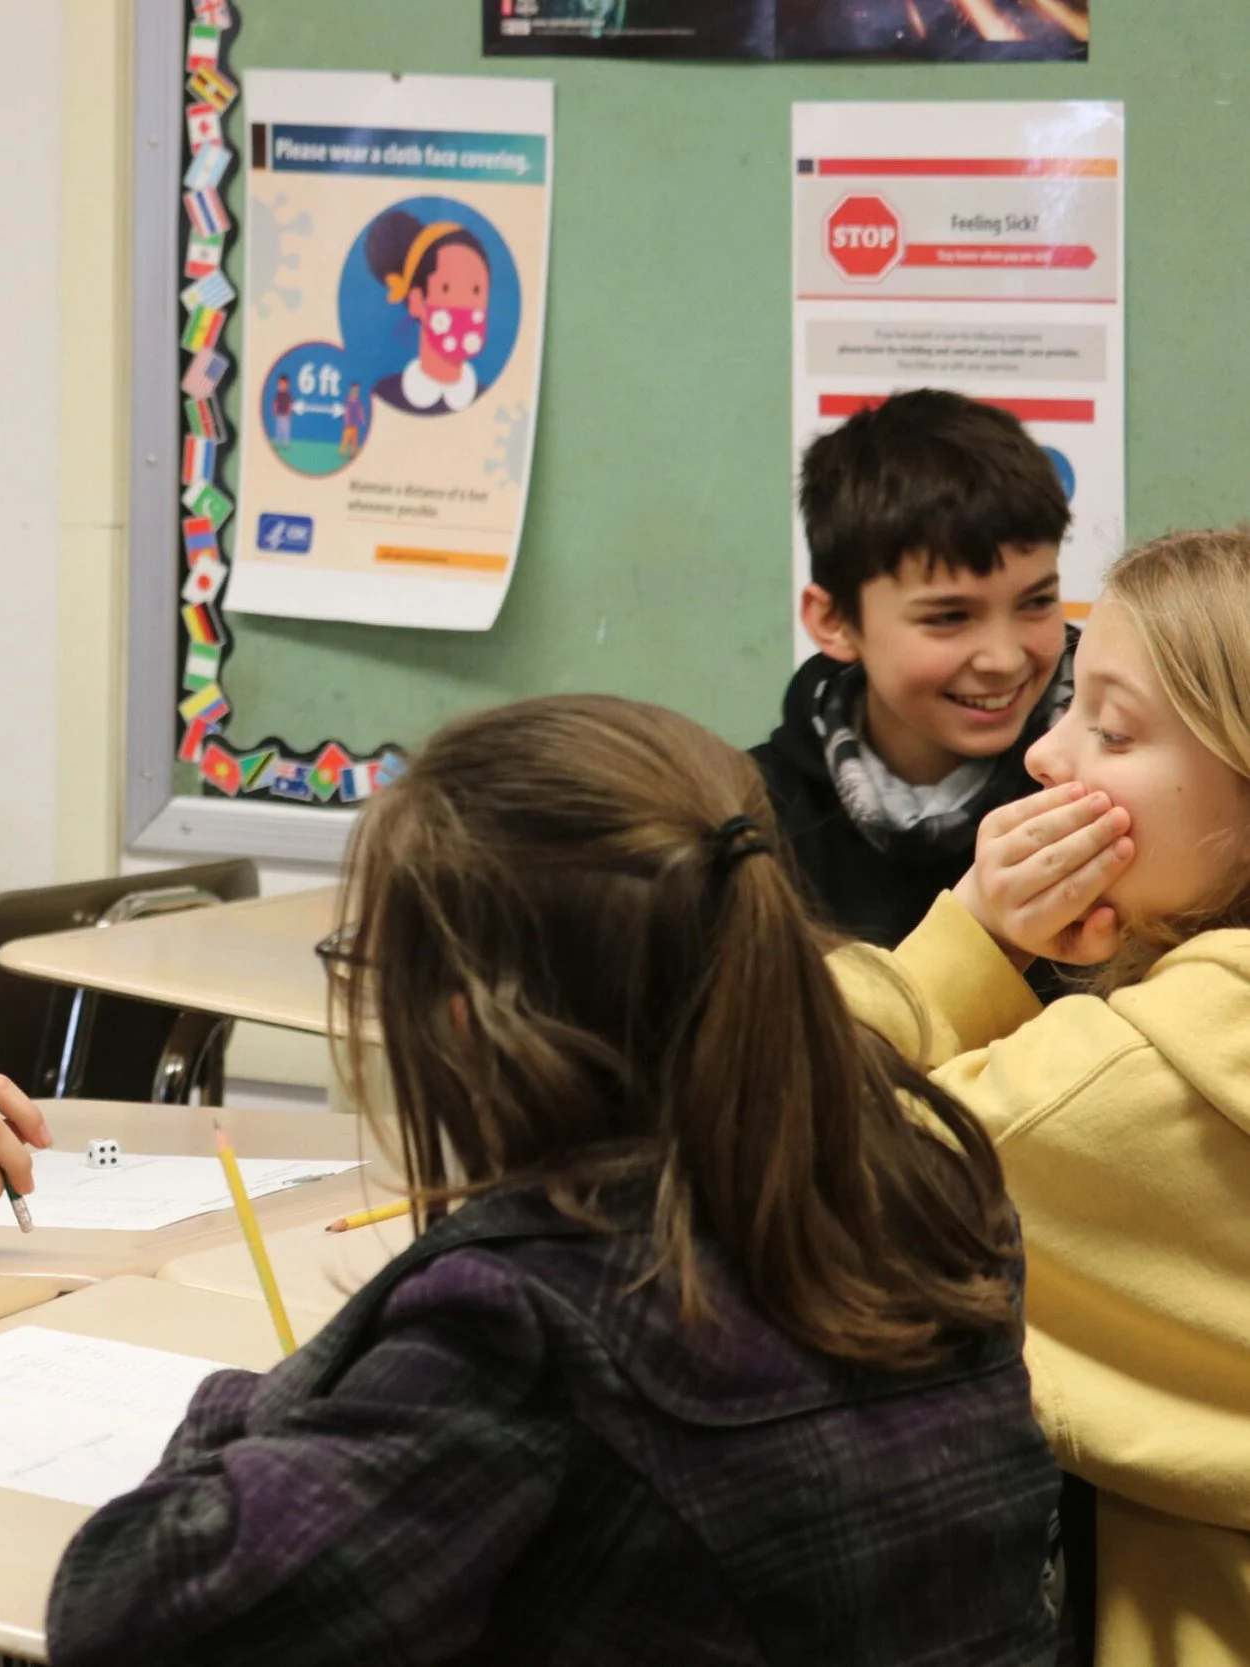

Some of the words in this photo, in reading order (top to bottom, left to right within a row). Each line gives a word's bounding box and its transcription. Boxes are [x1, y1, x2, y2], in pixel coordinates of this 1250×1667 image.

[275, 137, 327, 162] Please
[329, 143, 367, 163] wear
[370, 145, 381, 163] a
[383, 141, 423, 166] cloth
[426, 144, 458, 167] face
[951, 214, 1001, 235] Feeling
[1005, 215, 1039, 232] Sick?
[833, 227, 895, 248] STOP
[298, 362, 315, 395] 6
[318, 364, 342, 397] ft
